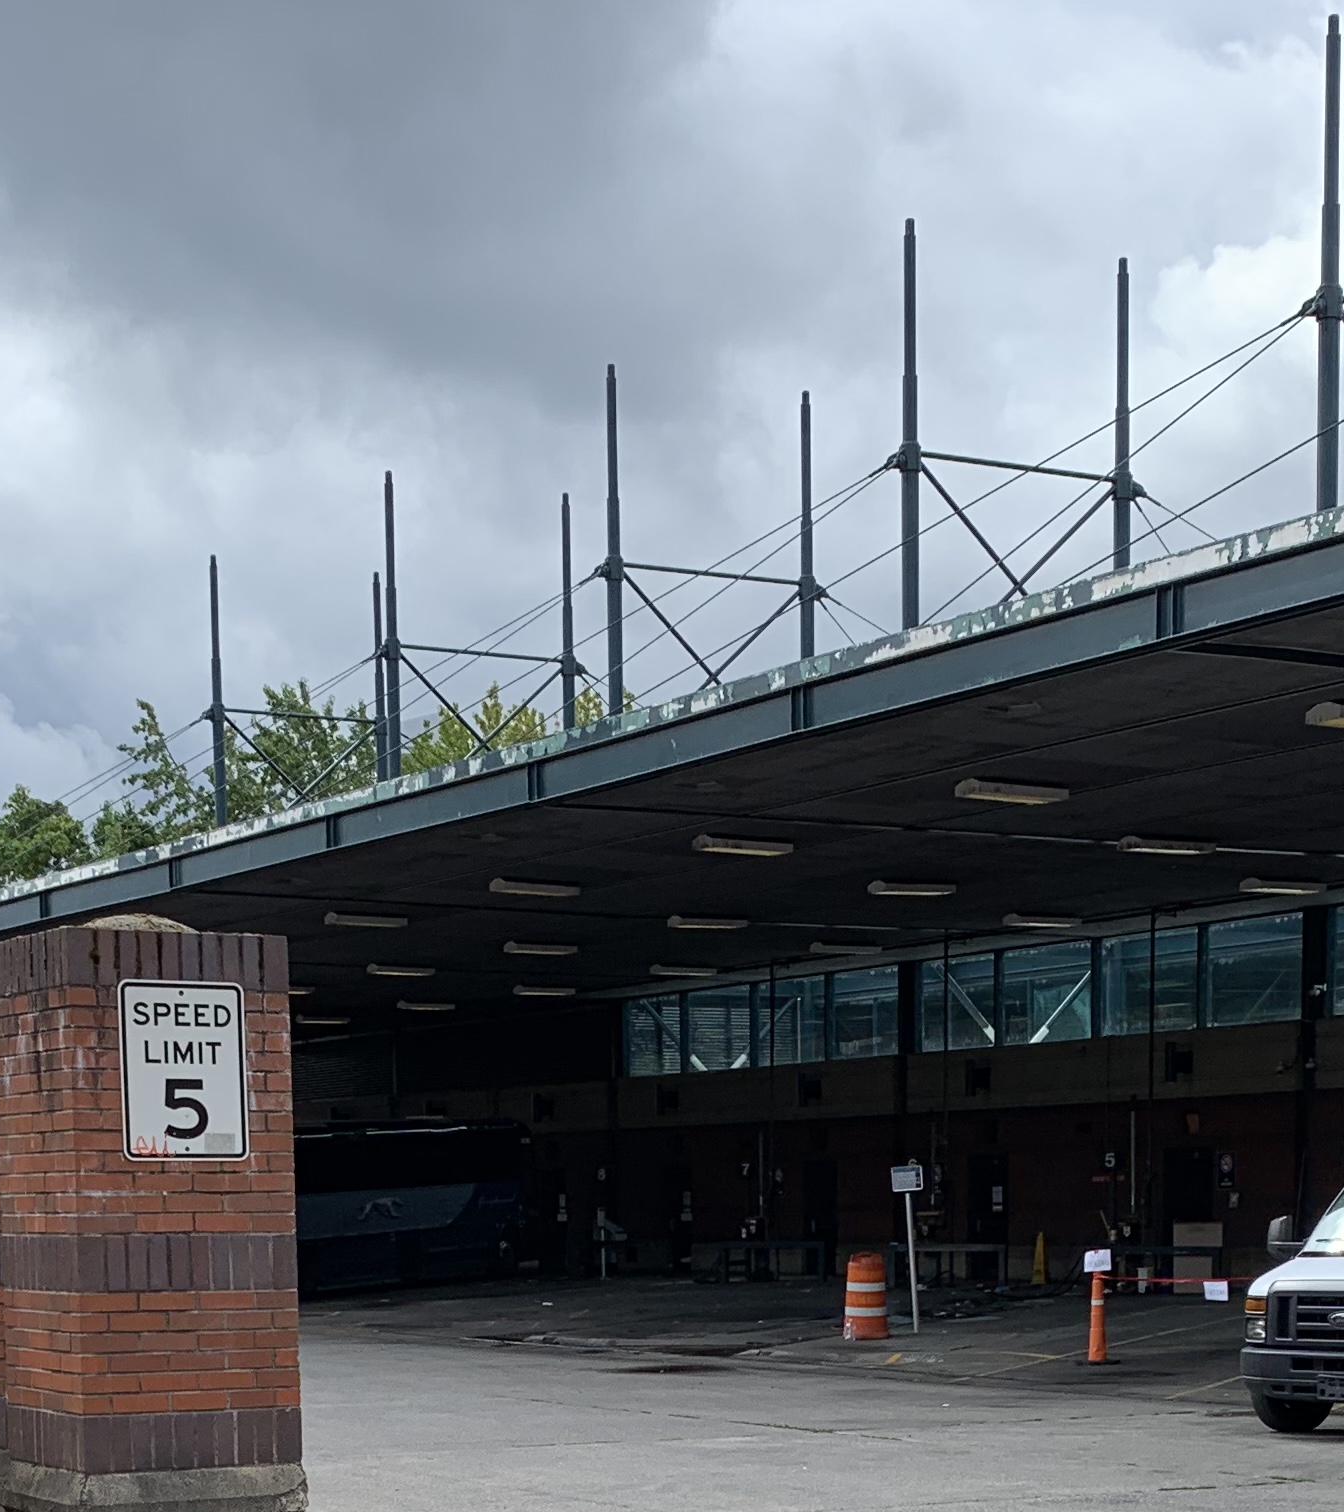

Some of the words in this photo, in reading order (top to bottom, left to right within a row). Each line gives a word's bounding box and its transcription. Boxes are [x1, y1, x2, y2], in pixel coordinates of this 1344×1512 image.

[133, 1002, 231, 1027] SPEED
[144, 1040, 221, 1064] LIMIT
[164, 1078, 208, 1139] 5
[742, 1163, 750, 1176] 7
[1104, 1152, 1116, 1168] 5
